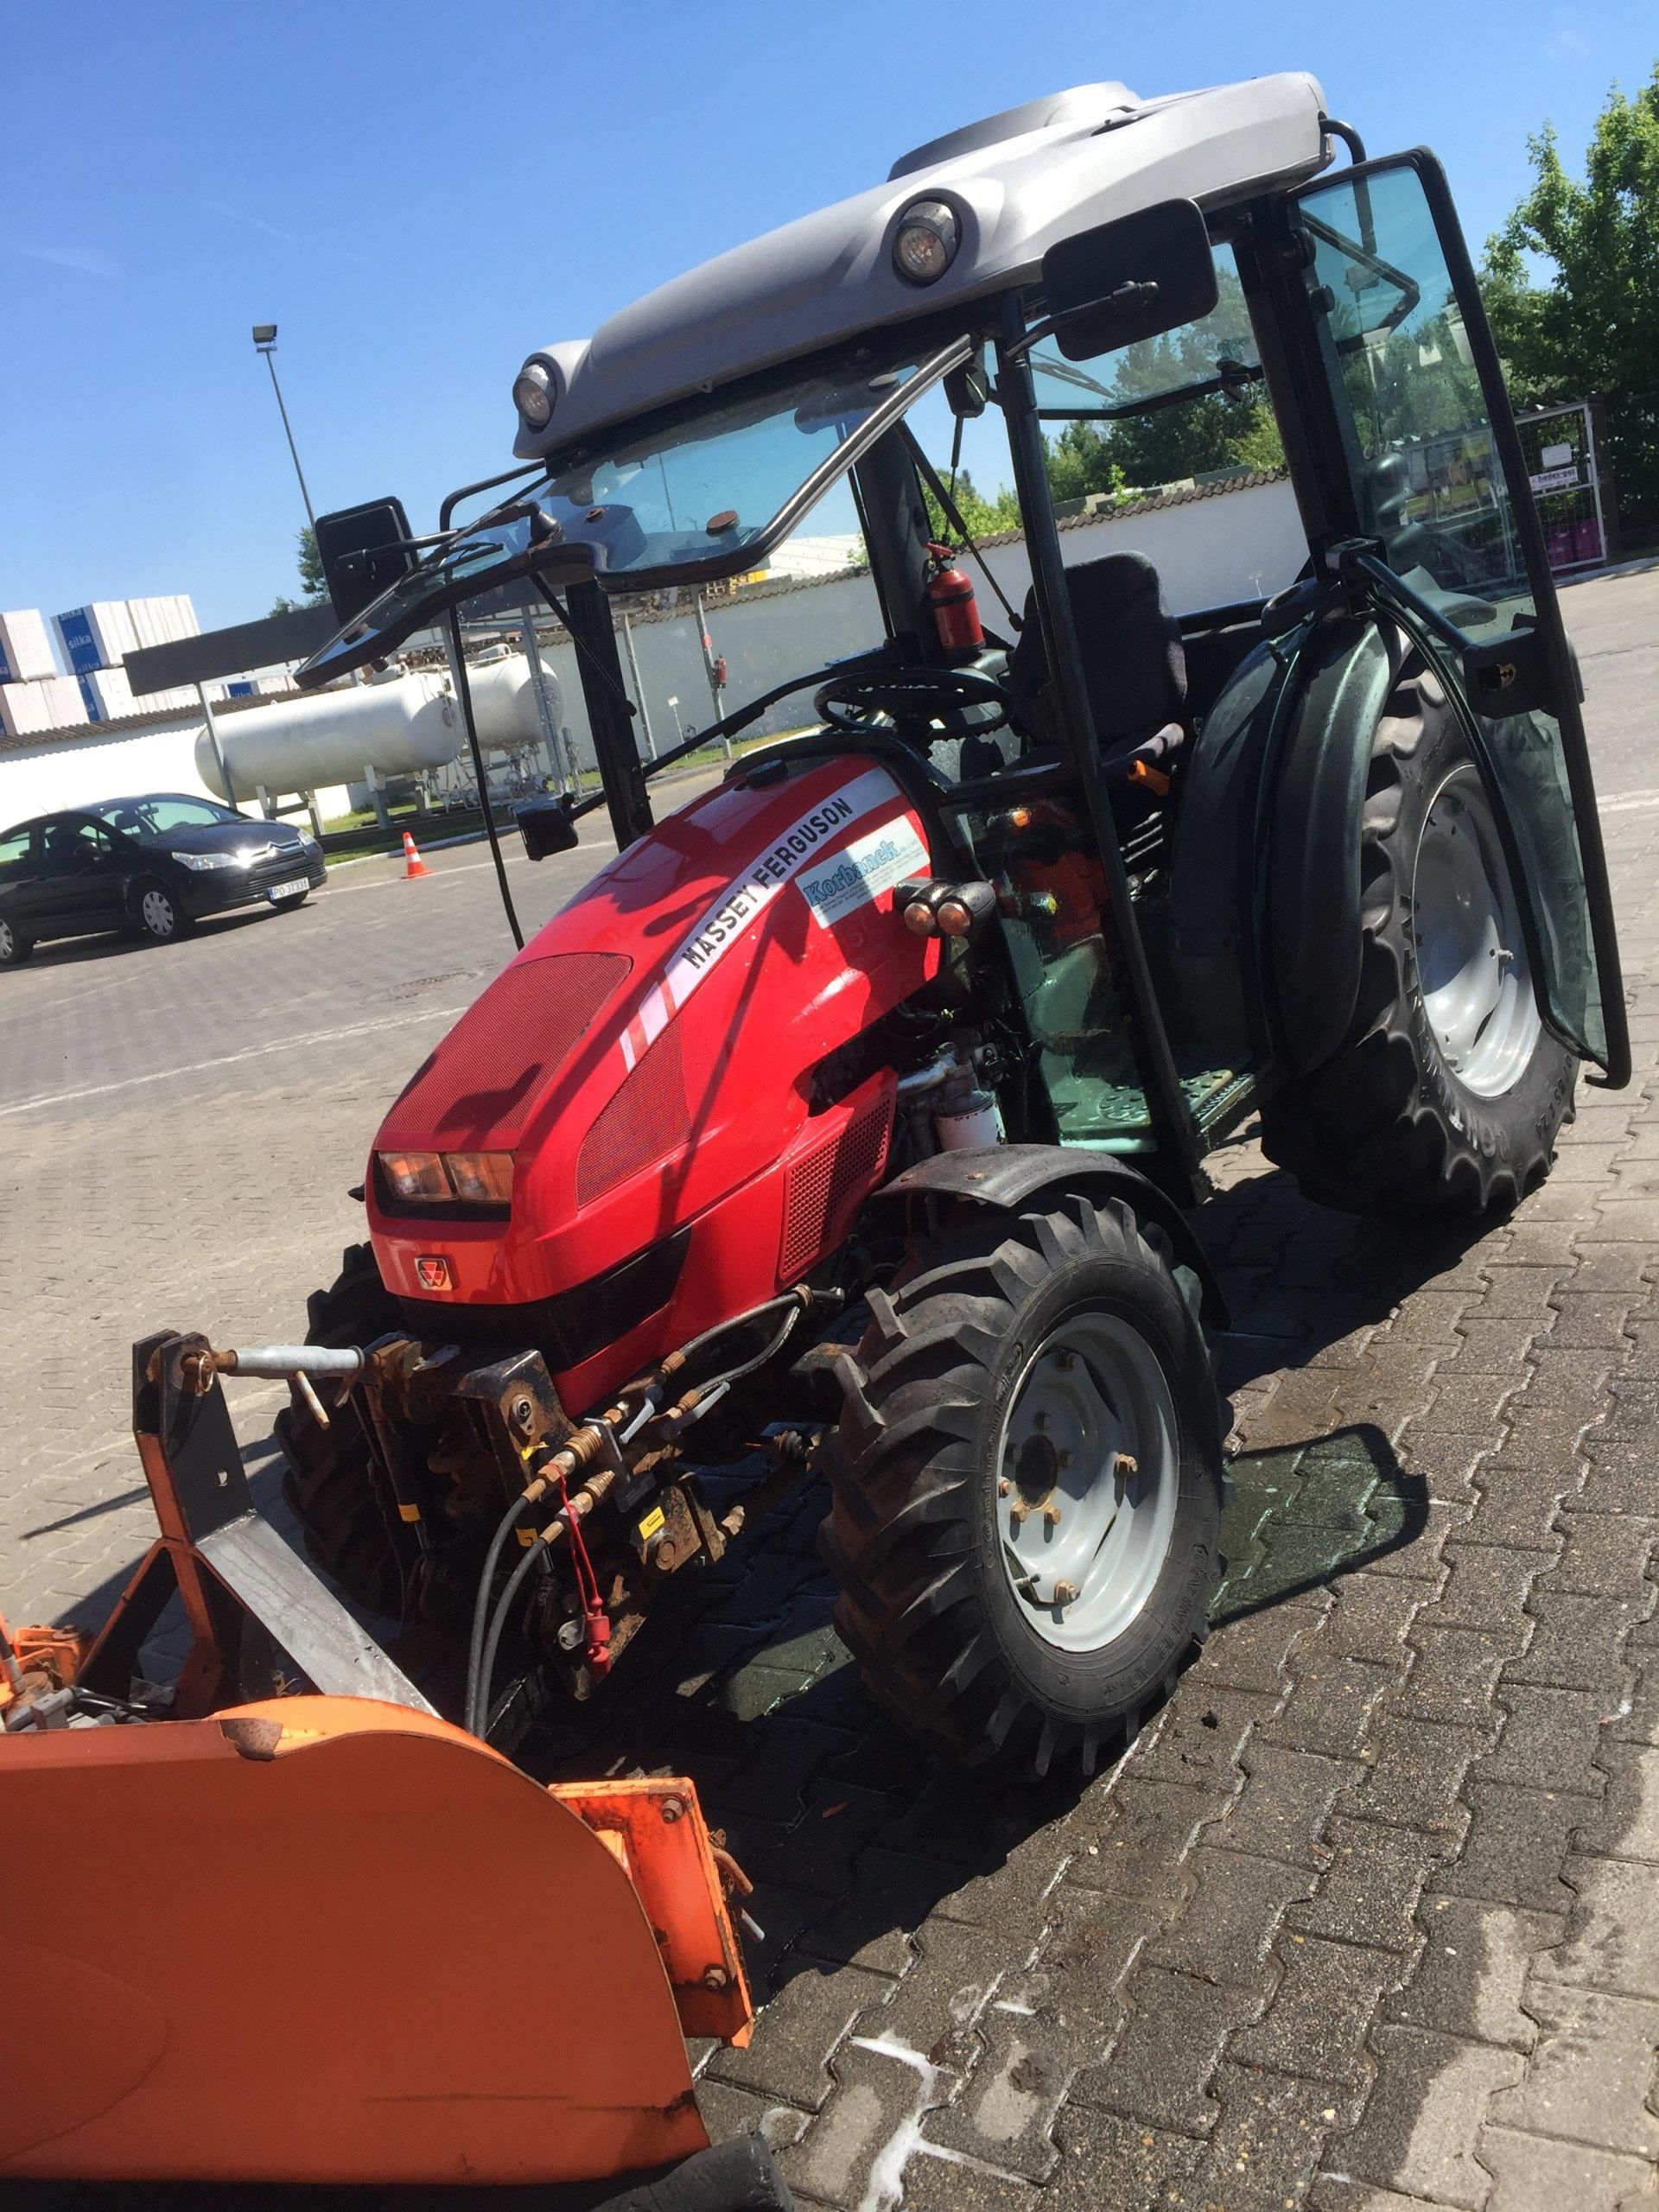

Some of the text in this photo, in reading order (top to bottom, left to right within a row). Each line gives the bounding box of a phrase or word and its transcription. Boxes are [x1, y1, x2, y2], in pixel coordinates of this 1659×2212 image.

[69, 633, 92, 649] silka
[681, 883, 759, 969] MASSEY
[751, 798, 854, 890] FERGUSON
[804, 840, 901, 907] Korbanek
